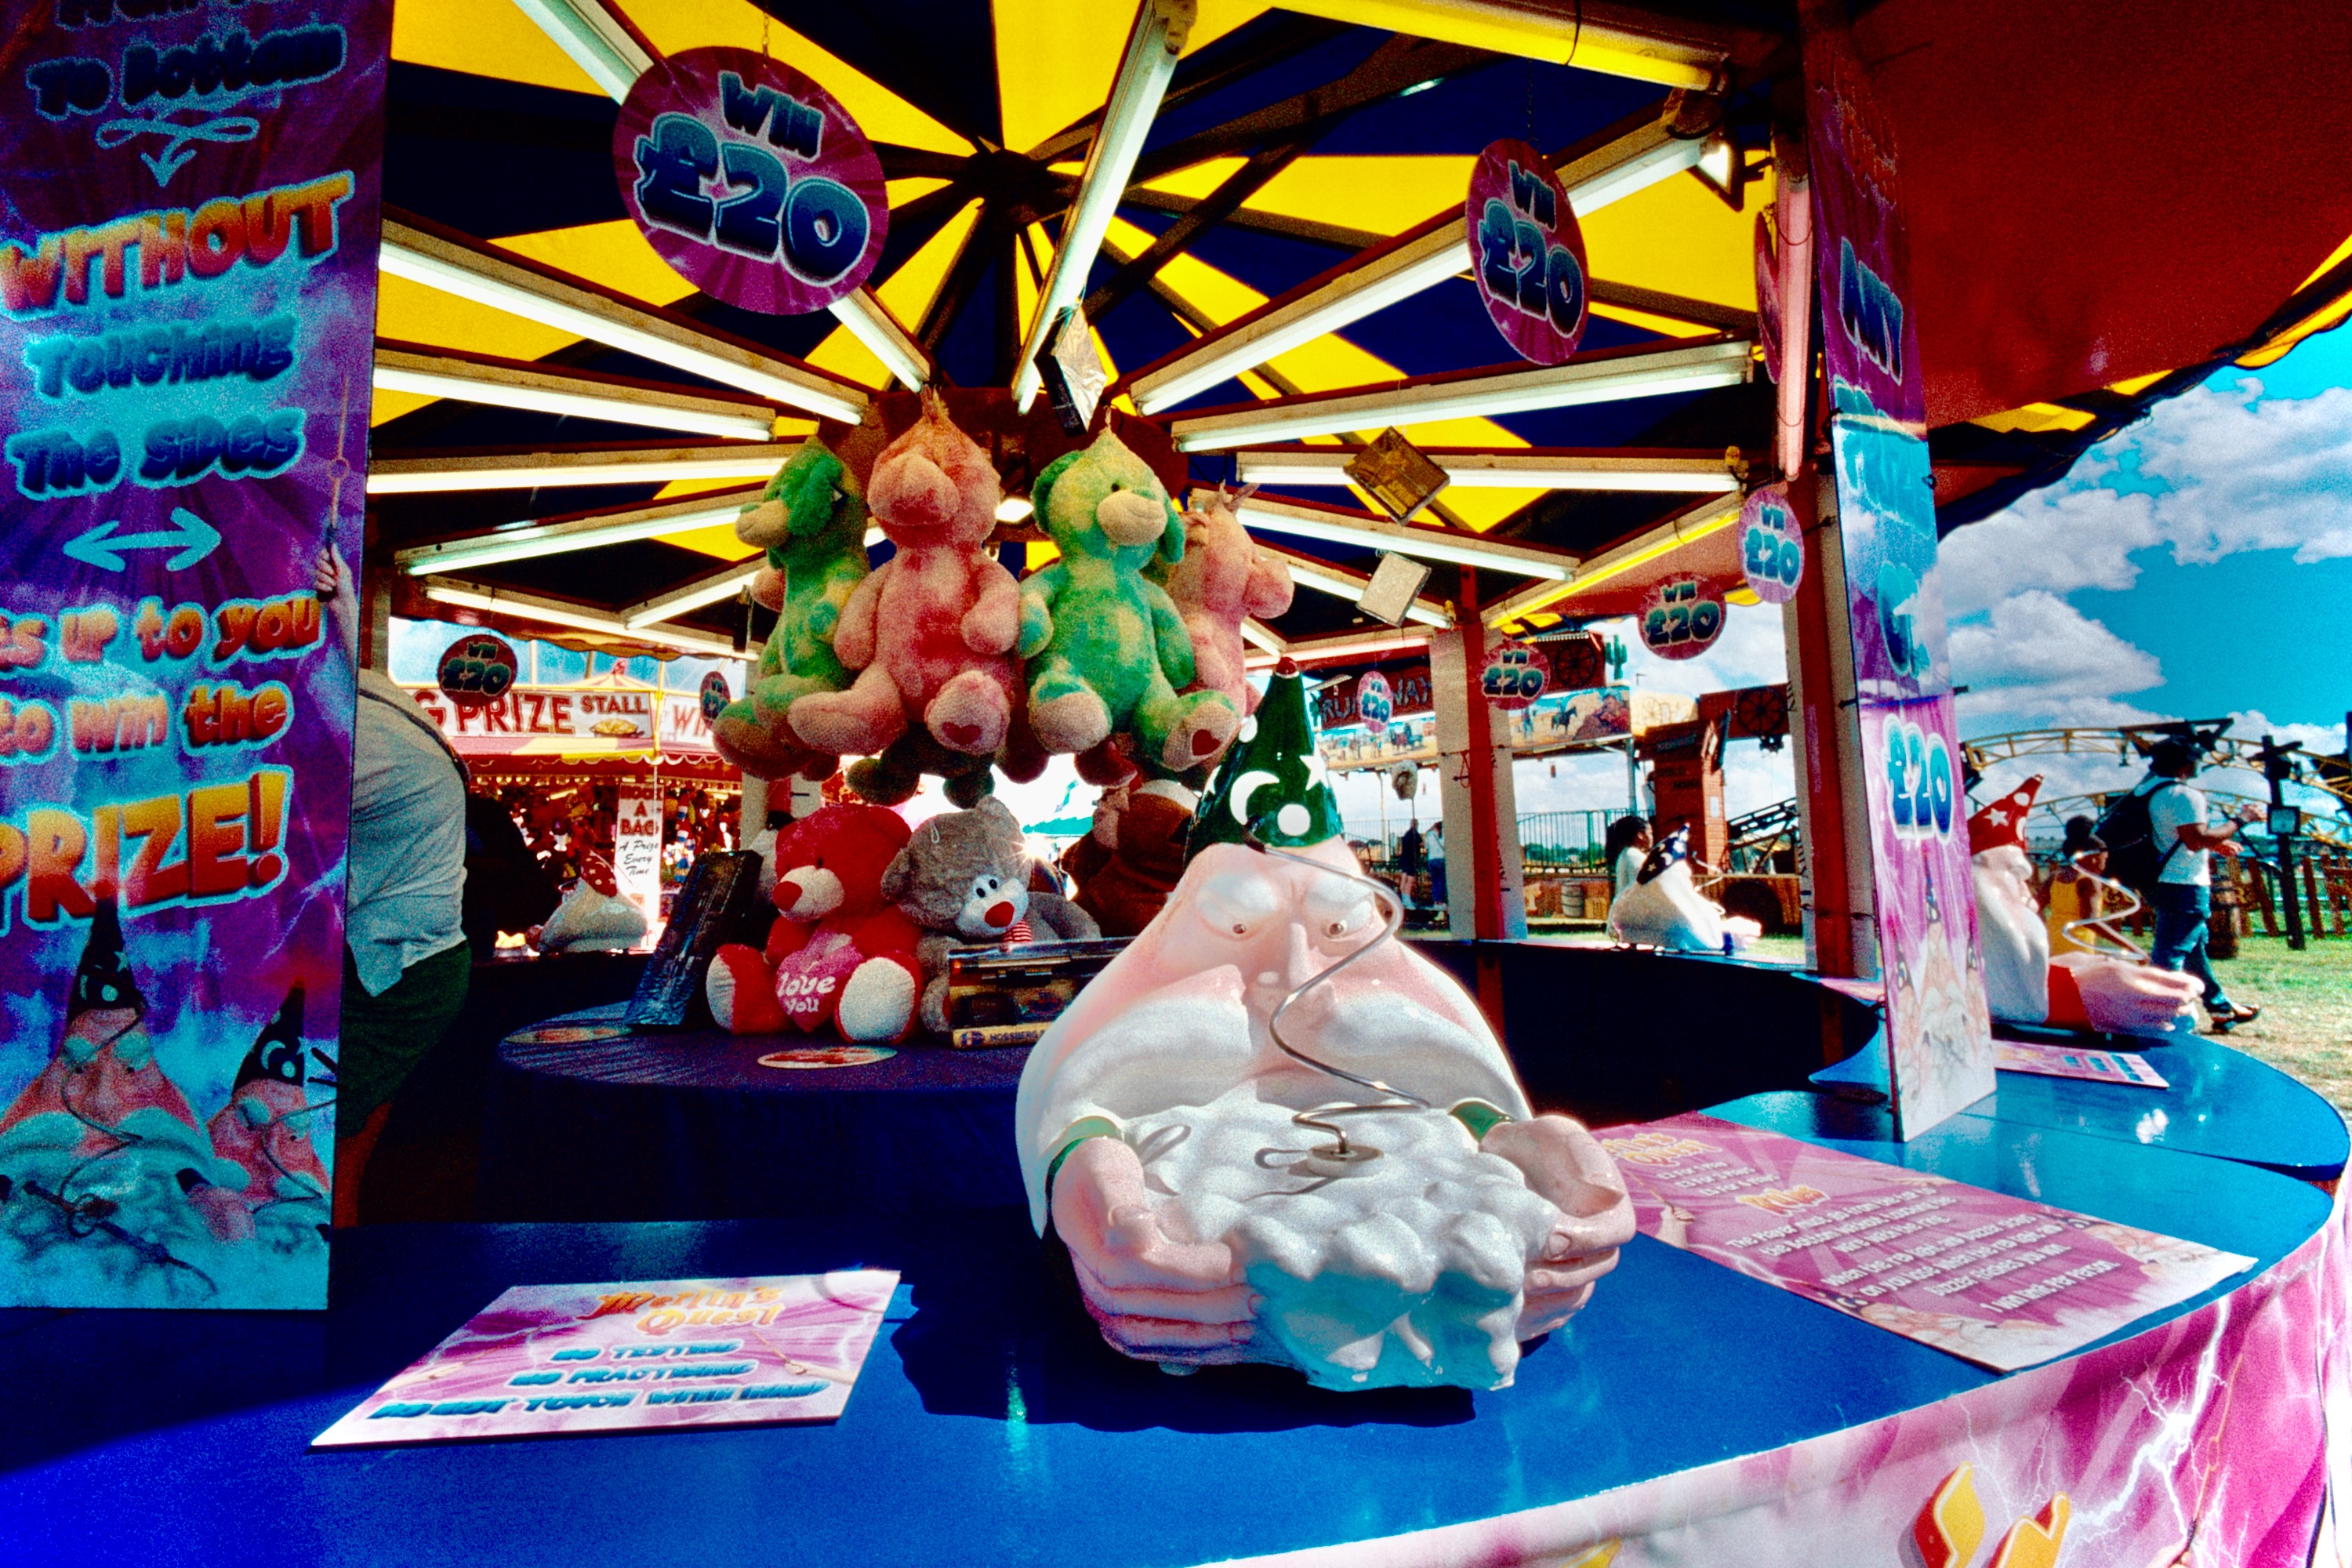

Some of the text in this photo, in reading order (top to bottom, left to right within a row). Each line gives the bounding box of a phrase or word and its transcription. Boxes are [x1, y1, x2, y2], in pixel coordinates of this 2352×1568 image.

[633, 111, 870, 287] £20
[0, 172, 352, 315] WITHOUT
[1478, 198, 1584, 339] £20
[1744, 526, 1801, 588] £20
[136, 602, 205, 662] to
[212, 597, 323, 661] you
[1645, 600, 1721, 648] £20
[442, 657, 512, 697] £20
[1483, 666, 1544, 701] £20
[184, 684, 289, 746] the
[456, 691, 575, 735] PRIZE
[580, 694, 650, 714] STALL
[1322, 677, 1432, 723] RUAY
[1882, 713, 1953, 846] £20
[620, 818, 659, 837] BAG
[633, 800, 648, 818] A
[623, 853, 653, 865] Every
[776, 972, 837, 997] love
[785, 996, 820, 1015] you
[575, 1286, 784, 1321] Merlin's
[636, 1304, 785, 1337] Quest
[524, 1390, 643, 1412] TOUCH
